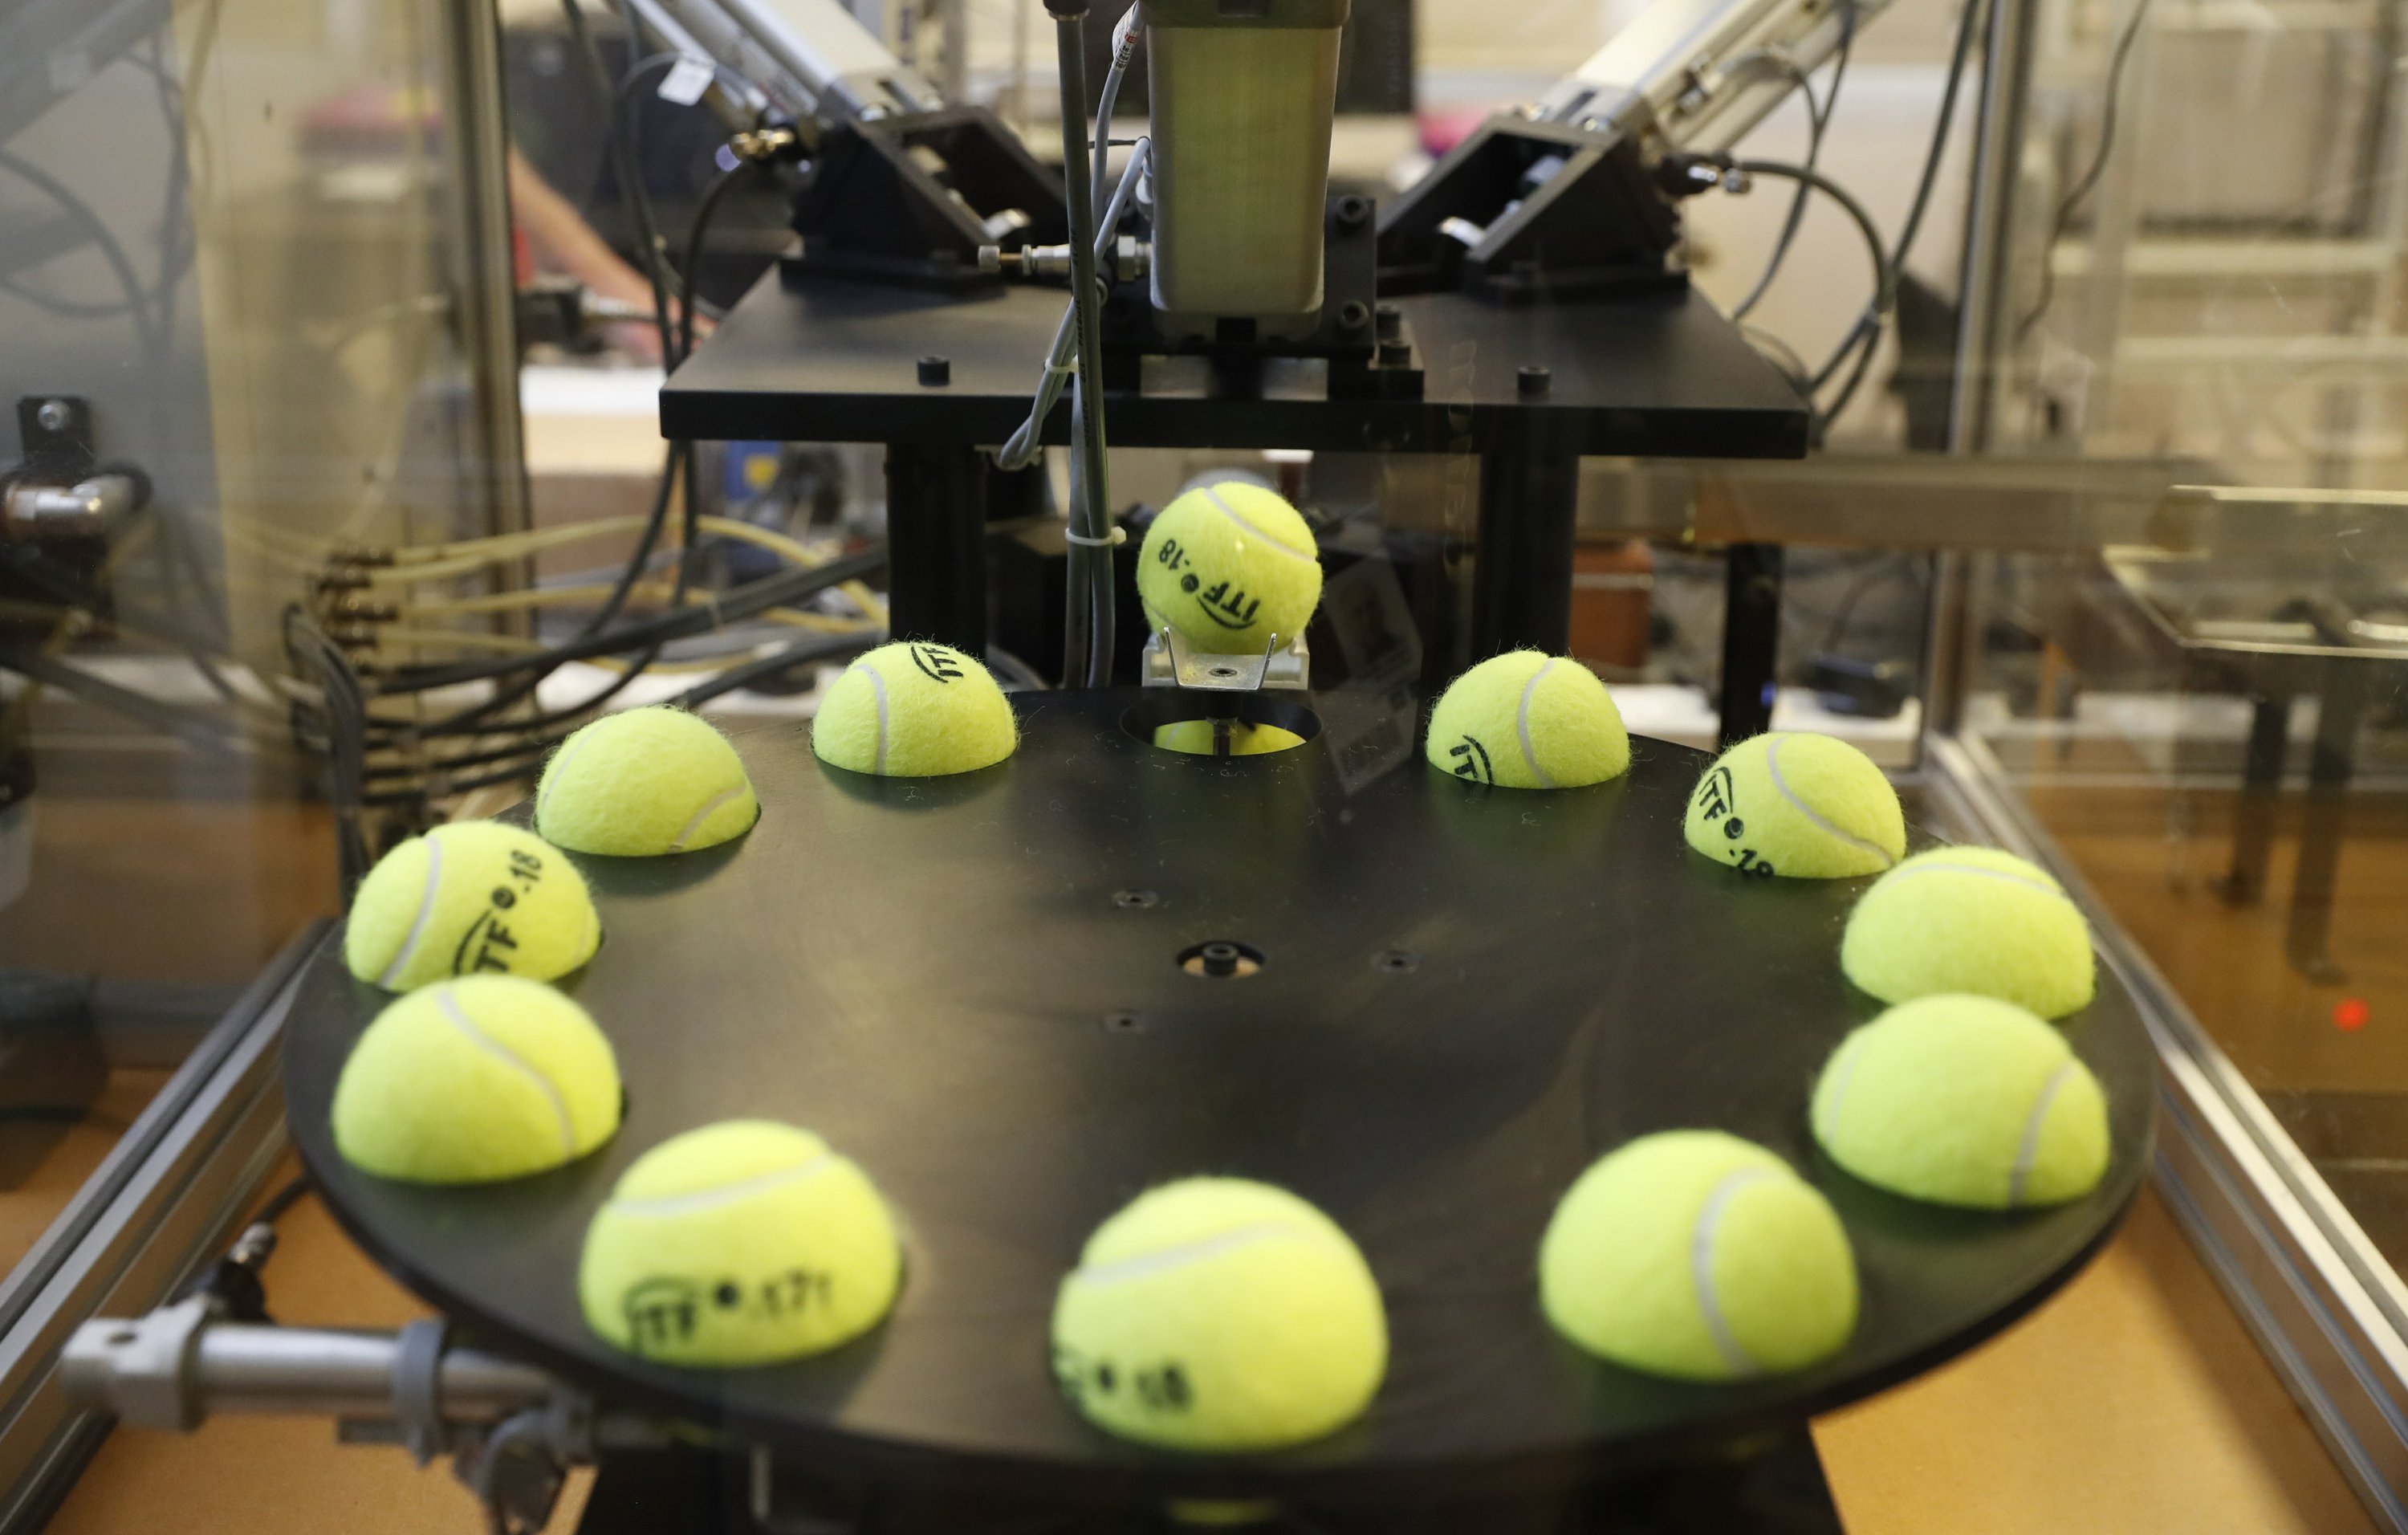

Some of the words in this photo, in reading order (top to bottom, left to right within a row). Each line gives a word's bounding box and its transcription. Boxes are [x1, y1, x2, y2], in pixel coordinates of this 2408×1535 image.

[1202, 581, 1260, 621] ITF
[919, 645, 964, 678] ITF
[1450, 742, 1482, 779] IT
[1698, 773, 1727, 820] ITF
[471, 918, 519, 973] TF
